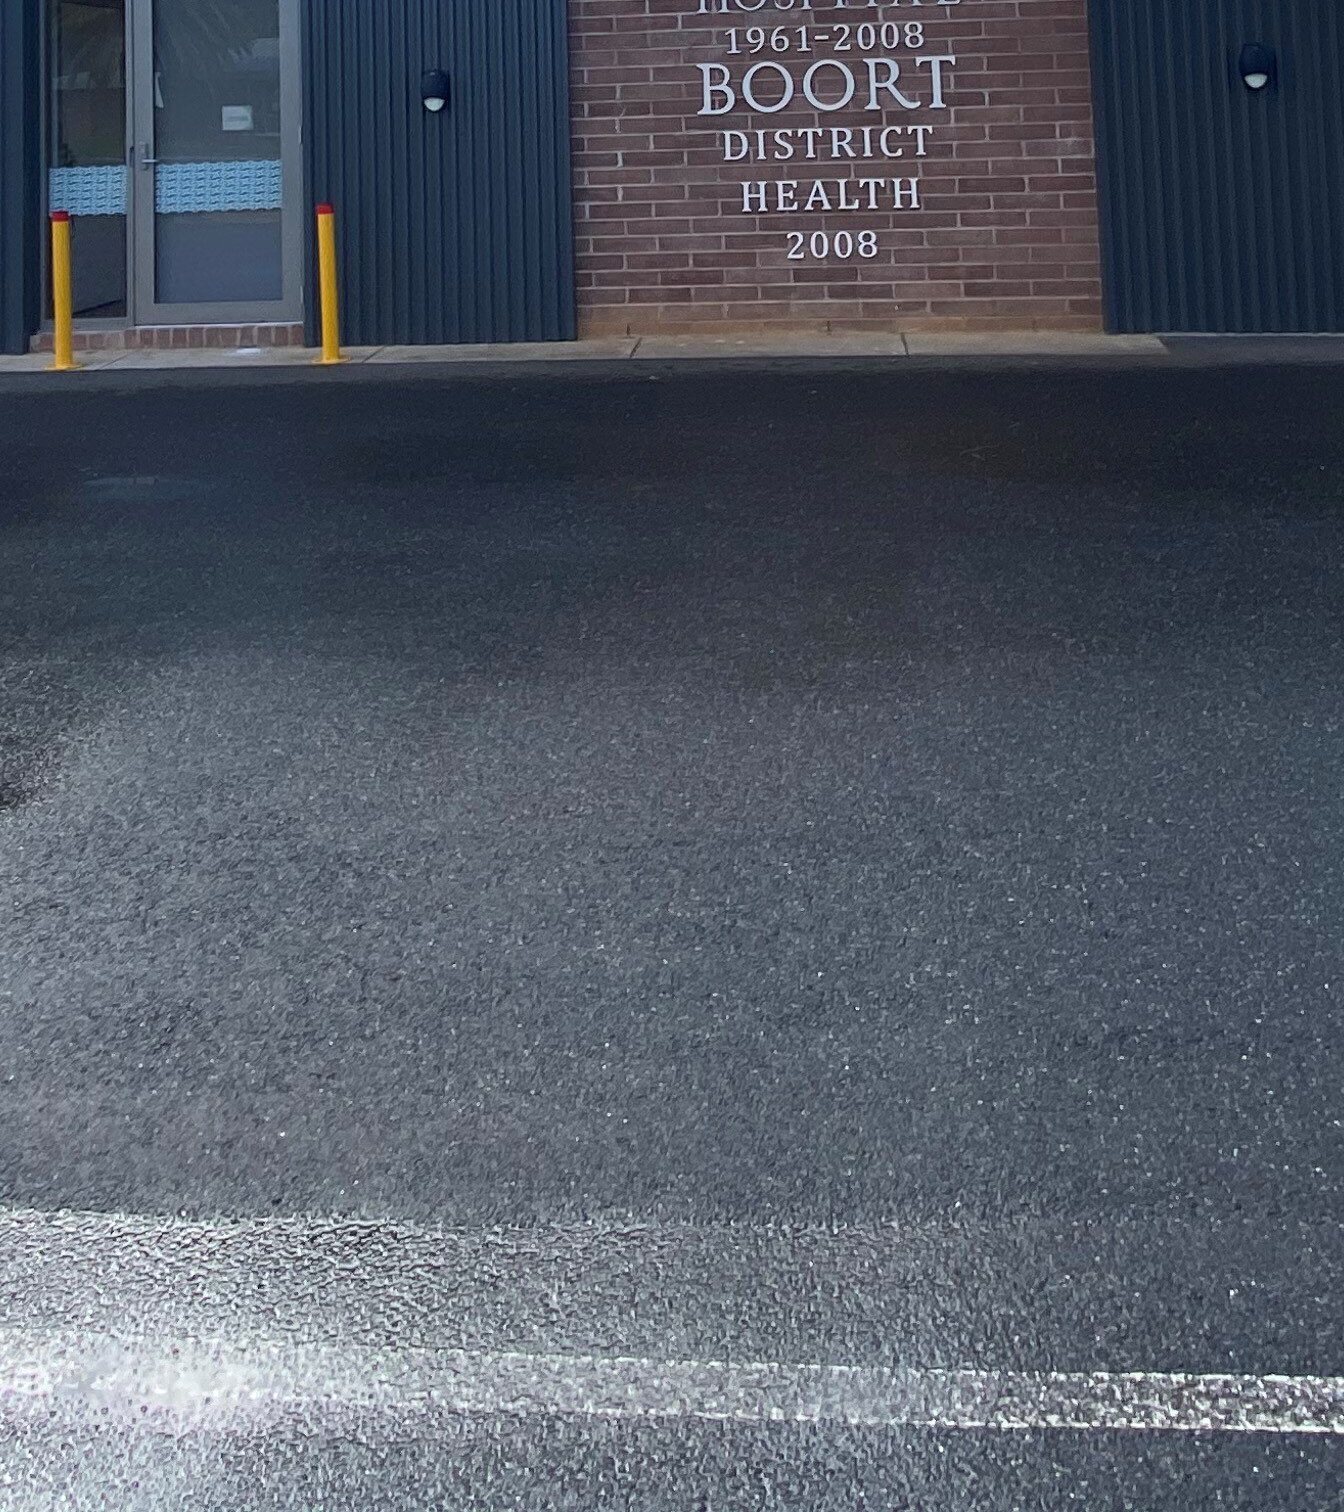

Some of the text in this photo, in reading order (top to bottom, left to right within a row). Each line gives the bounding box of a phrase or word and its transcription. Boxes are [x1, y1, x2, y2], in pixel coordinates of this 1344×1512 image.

[724, 21, 925, 54] 1961-2008
[696, 55, 956, 116] BOORT
[722, 125, 933, 161] DISTRICT
[740, 177, 921, 213] HEALTH
[786, 230, 878, 260] 2008
